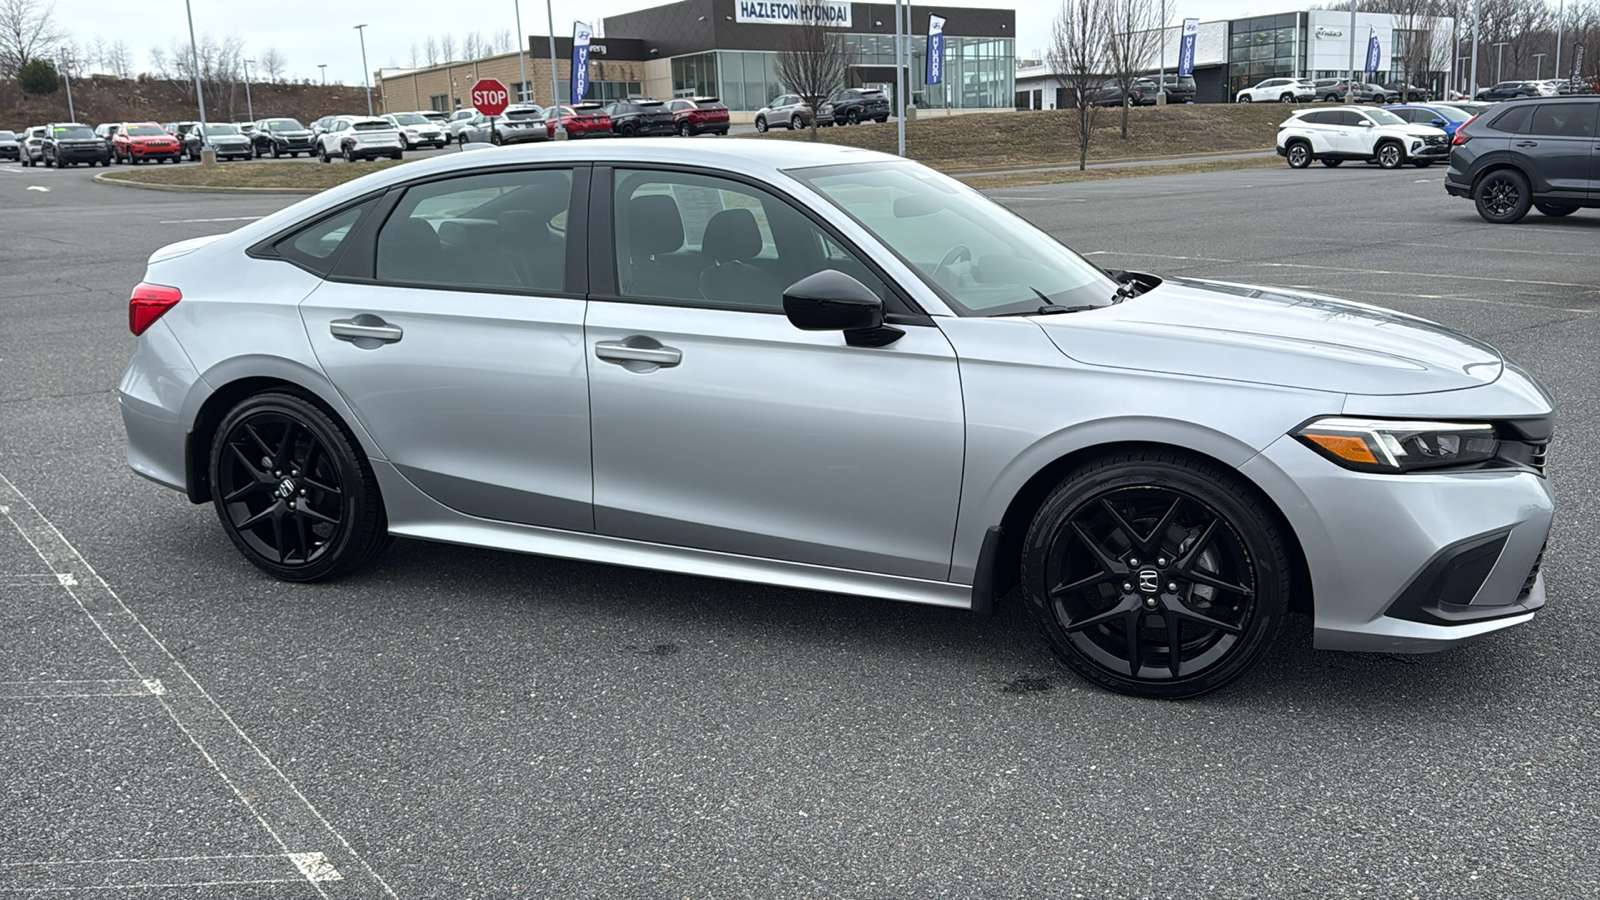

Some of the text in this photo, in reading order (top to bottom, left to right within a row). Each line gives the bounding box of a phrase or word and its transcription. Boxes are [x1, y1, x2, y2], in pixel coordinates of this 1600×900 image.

[741, 2, 847, 22] HAZLETON HYUNDAI
[577, 48, 587, 100] HYUNDAI
[473, 90, 507, 106] STOP
